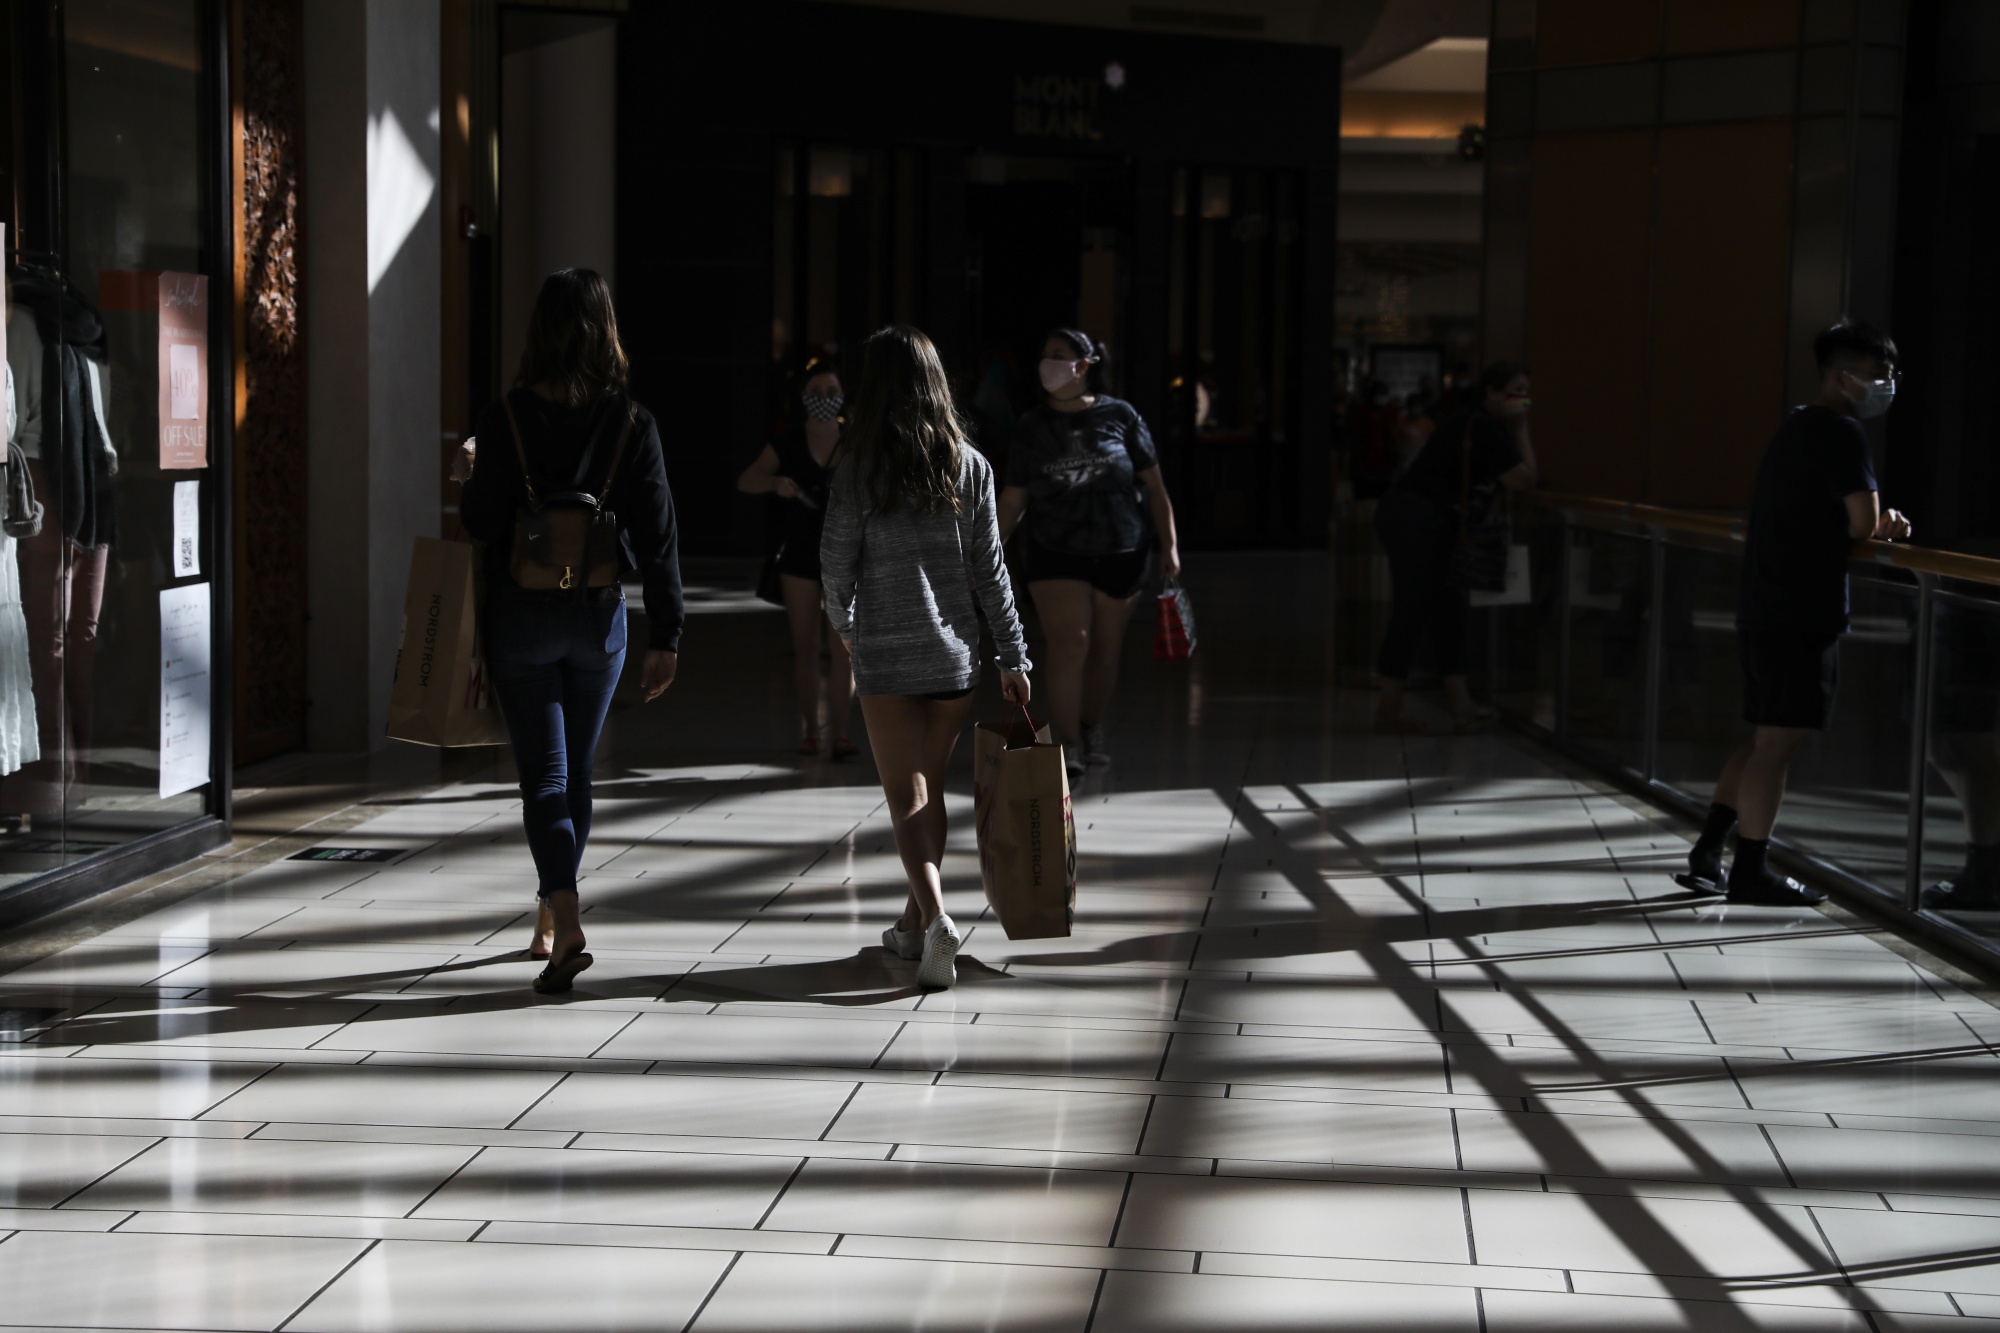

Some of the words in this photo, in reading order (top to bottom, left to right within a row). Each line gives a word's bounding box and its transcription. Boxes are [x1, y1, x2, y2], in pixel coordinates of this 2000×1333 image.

[1014, 74, 1102, 108] MONT
[1014, 105, 1103, 142] BLANC
[164, 425, 182, 447] OFF
[184, 425, 204, 448] SALE
[1042, 454, 1115, 473] CHAMPIONS
[419, 594, 441, 687] NORDSTROM
[1029, 798, 1043, 888] NORDSTROM
